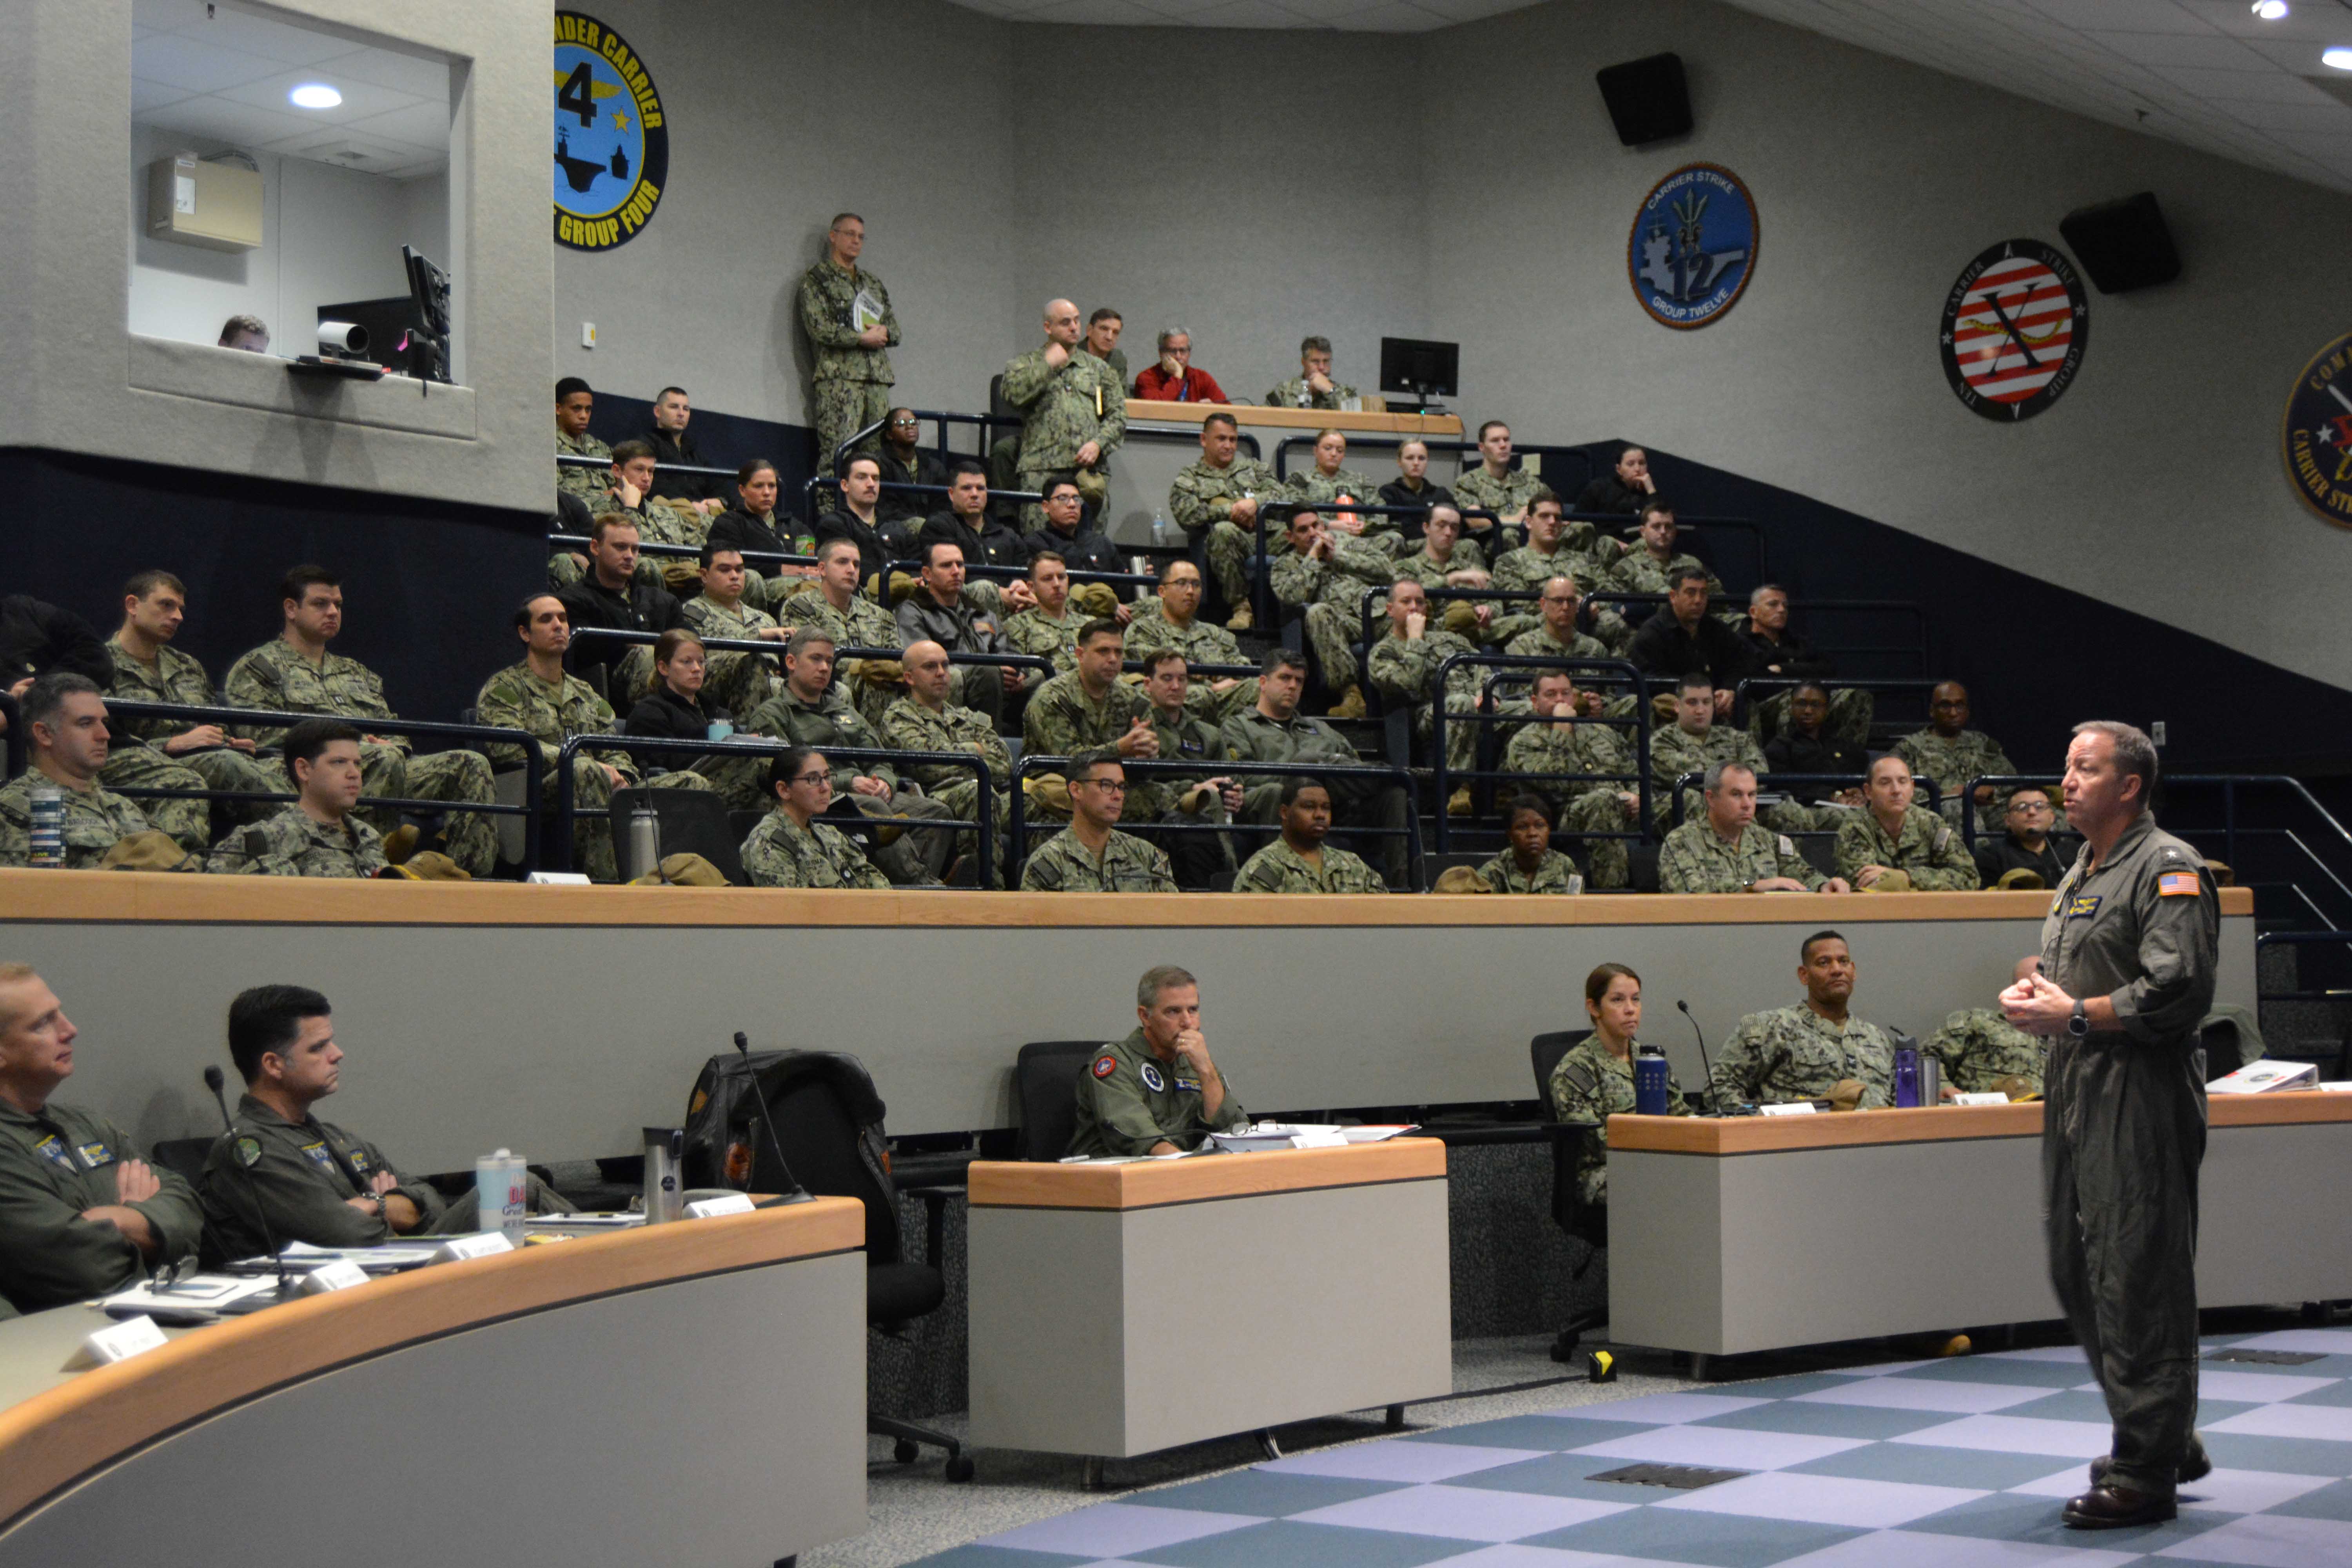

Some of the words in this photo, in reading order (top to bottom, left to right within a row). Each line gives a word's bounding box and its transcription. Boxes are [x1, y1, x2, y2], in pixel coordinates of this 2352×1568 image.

[558, 62, 597, 128] 4
[602, 33, 662, 129] CARRIER
[559, 216, 619, 247] GROUP
[620, 179, 660, 234] FOUR
[1648, 173, 1693, 210] CARRIER
[1696, 172, 1735, 195] STRIKE
[1652, 296, 1686, 318] GROUP
[1689, 288, 1729, 317] TWELVE
[1668, 252, 1714, 301] 12
[1948, 261, 1984, 317] CARRIER
[2049, 348, 2077, 397] GROUP
[2293, 428, 2330, 498] CARRIER
